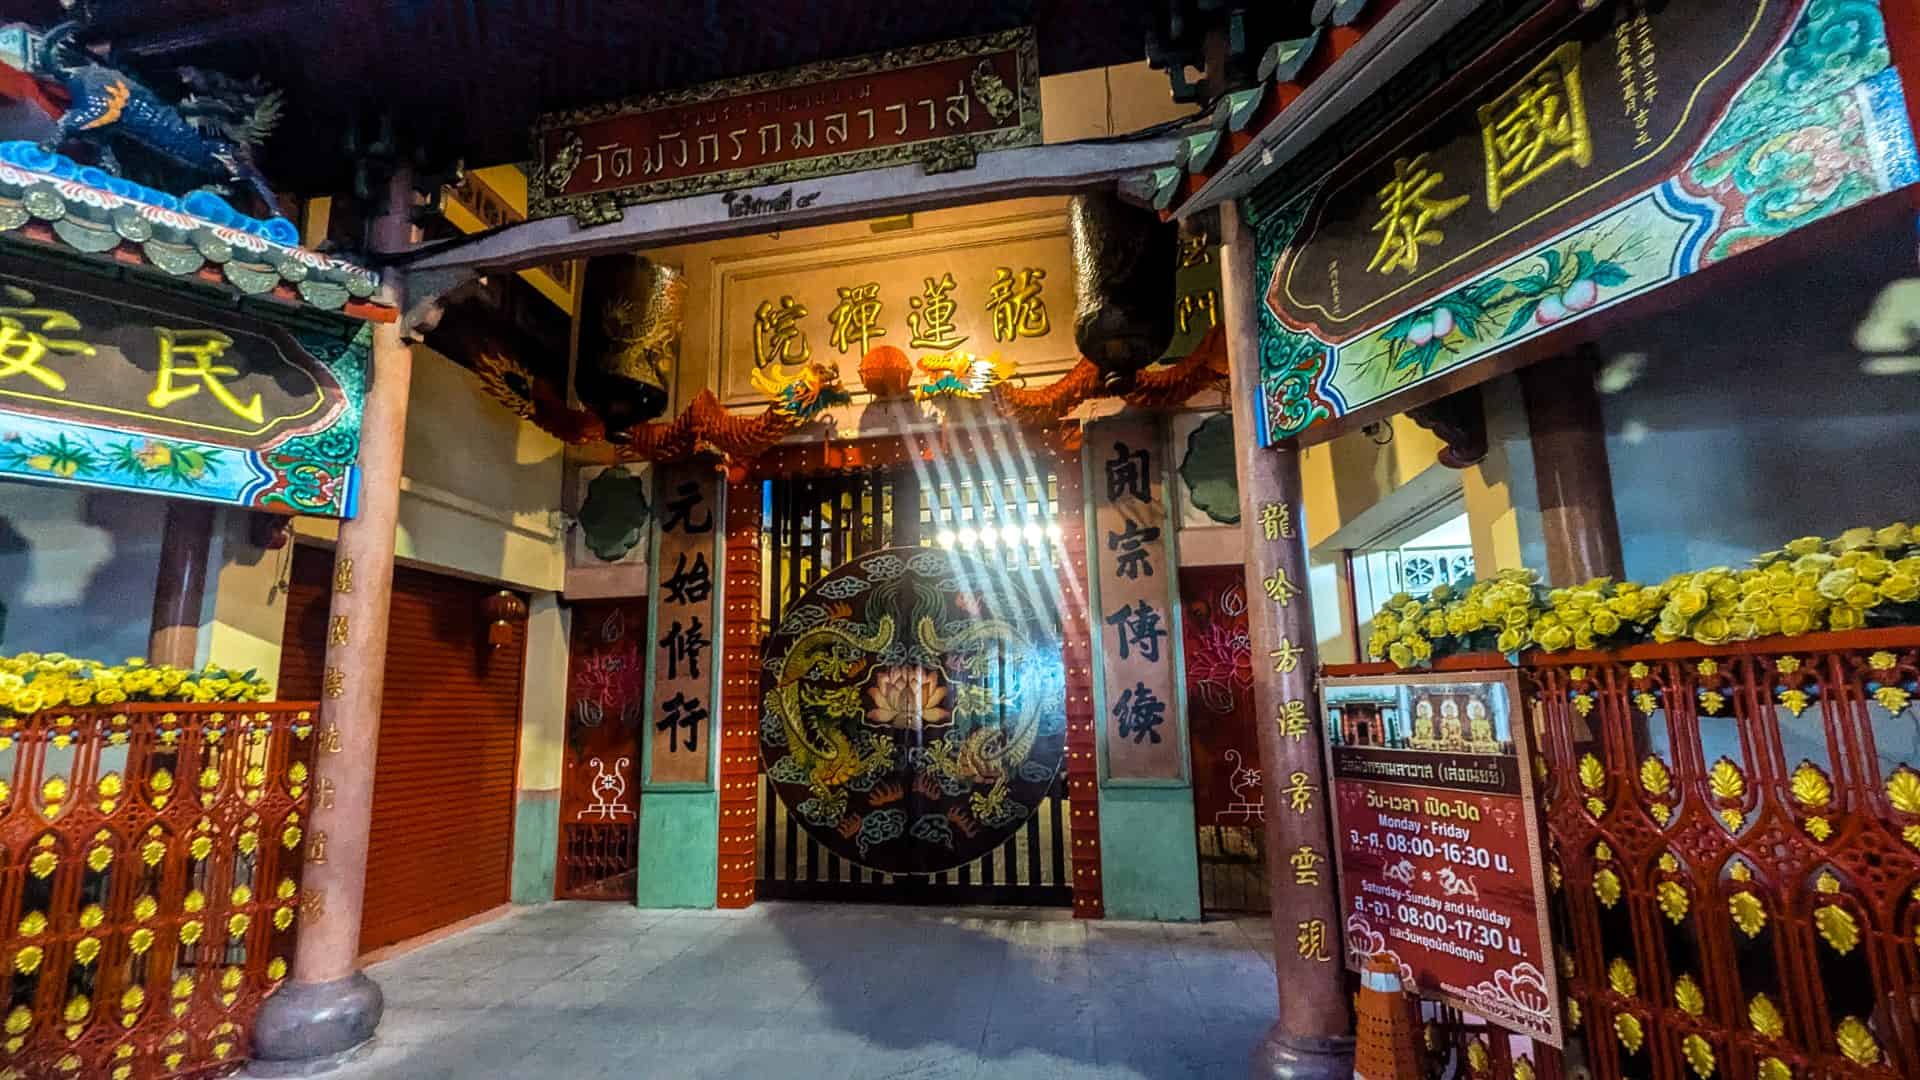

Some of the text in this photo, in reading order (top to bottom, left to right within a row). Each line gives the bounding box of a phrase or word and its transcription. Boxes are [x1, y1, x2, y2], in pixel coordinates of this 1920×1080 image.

[1367, 789, 1480, 821] วัน-เวลา เปิด-ปิด
[1378, 814, 1421, 834] Monday
[1431, 821, 1470, 842] Friday
[1386, 833, 1490, 869] 08:00-16:30
[1398, 905, 1503, 949] 08:00-17:30
[1444, 900, 1465, 915] and
[1467, 905, 1511, 929] Holiday
